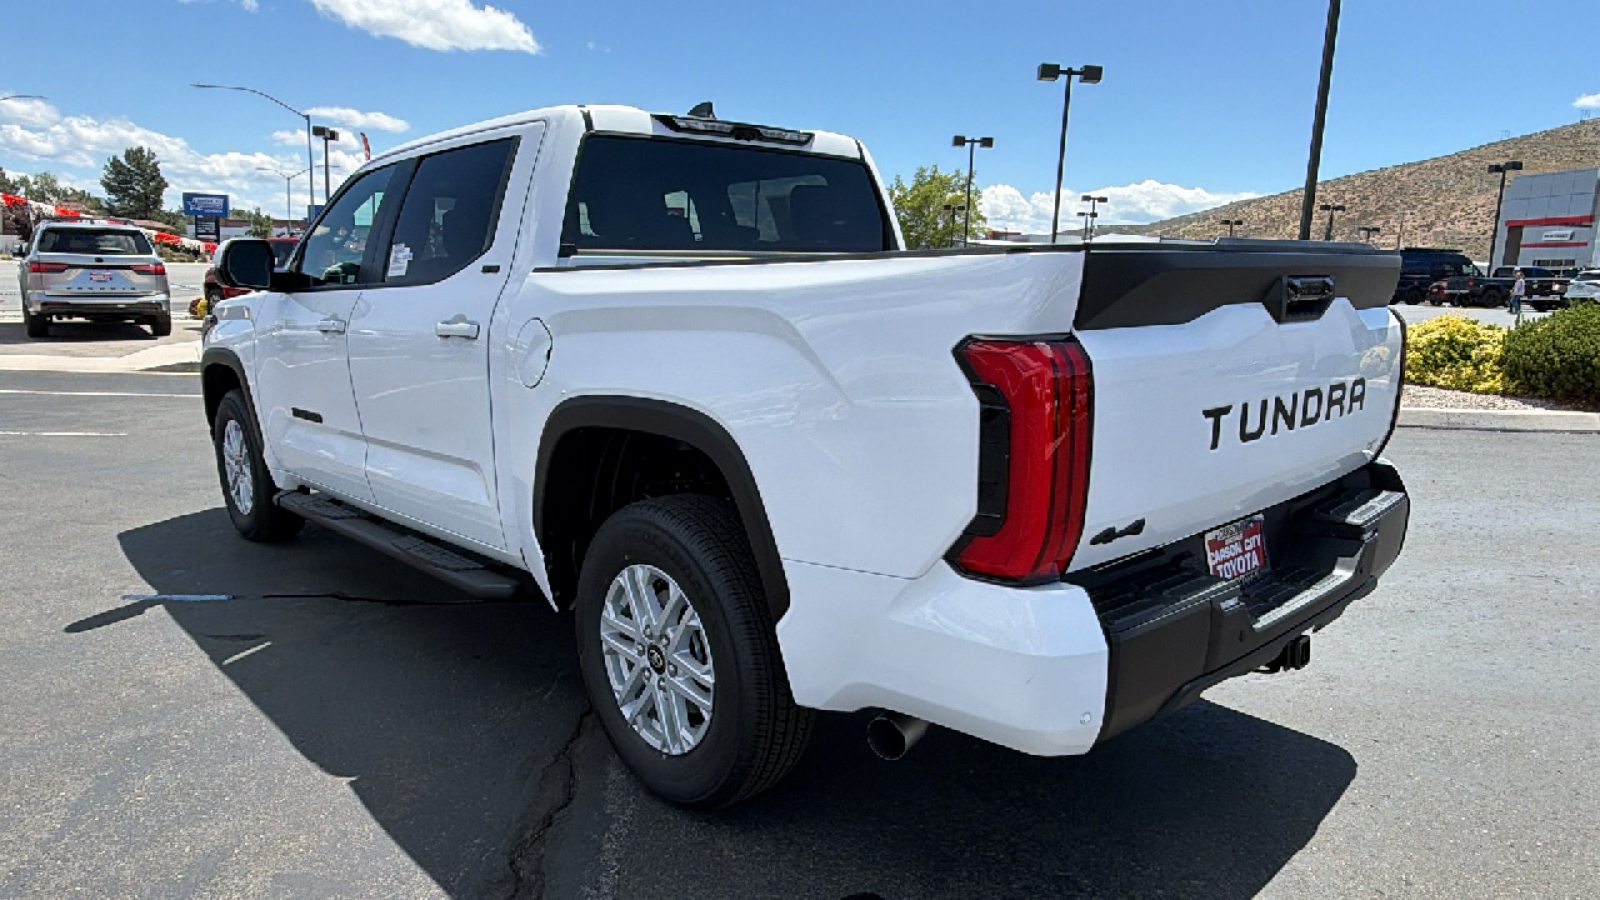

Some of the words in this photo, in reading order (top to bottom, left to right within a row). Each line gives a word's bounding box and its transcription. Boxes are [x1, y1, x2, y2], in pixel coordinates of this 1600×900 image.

[1202, 378, 1366, 450] TUNDRA
[1209, 543, 1243, 567] CARSON
[1244, 534, 1261, 551] CITY
[1216, 551, 1260, 580] TOYOTA
